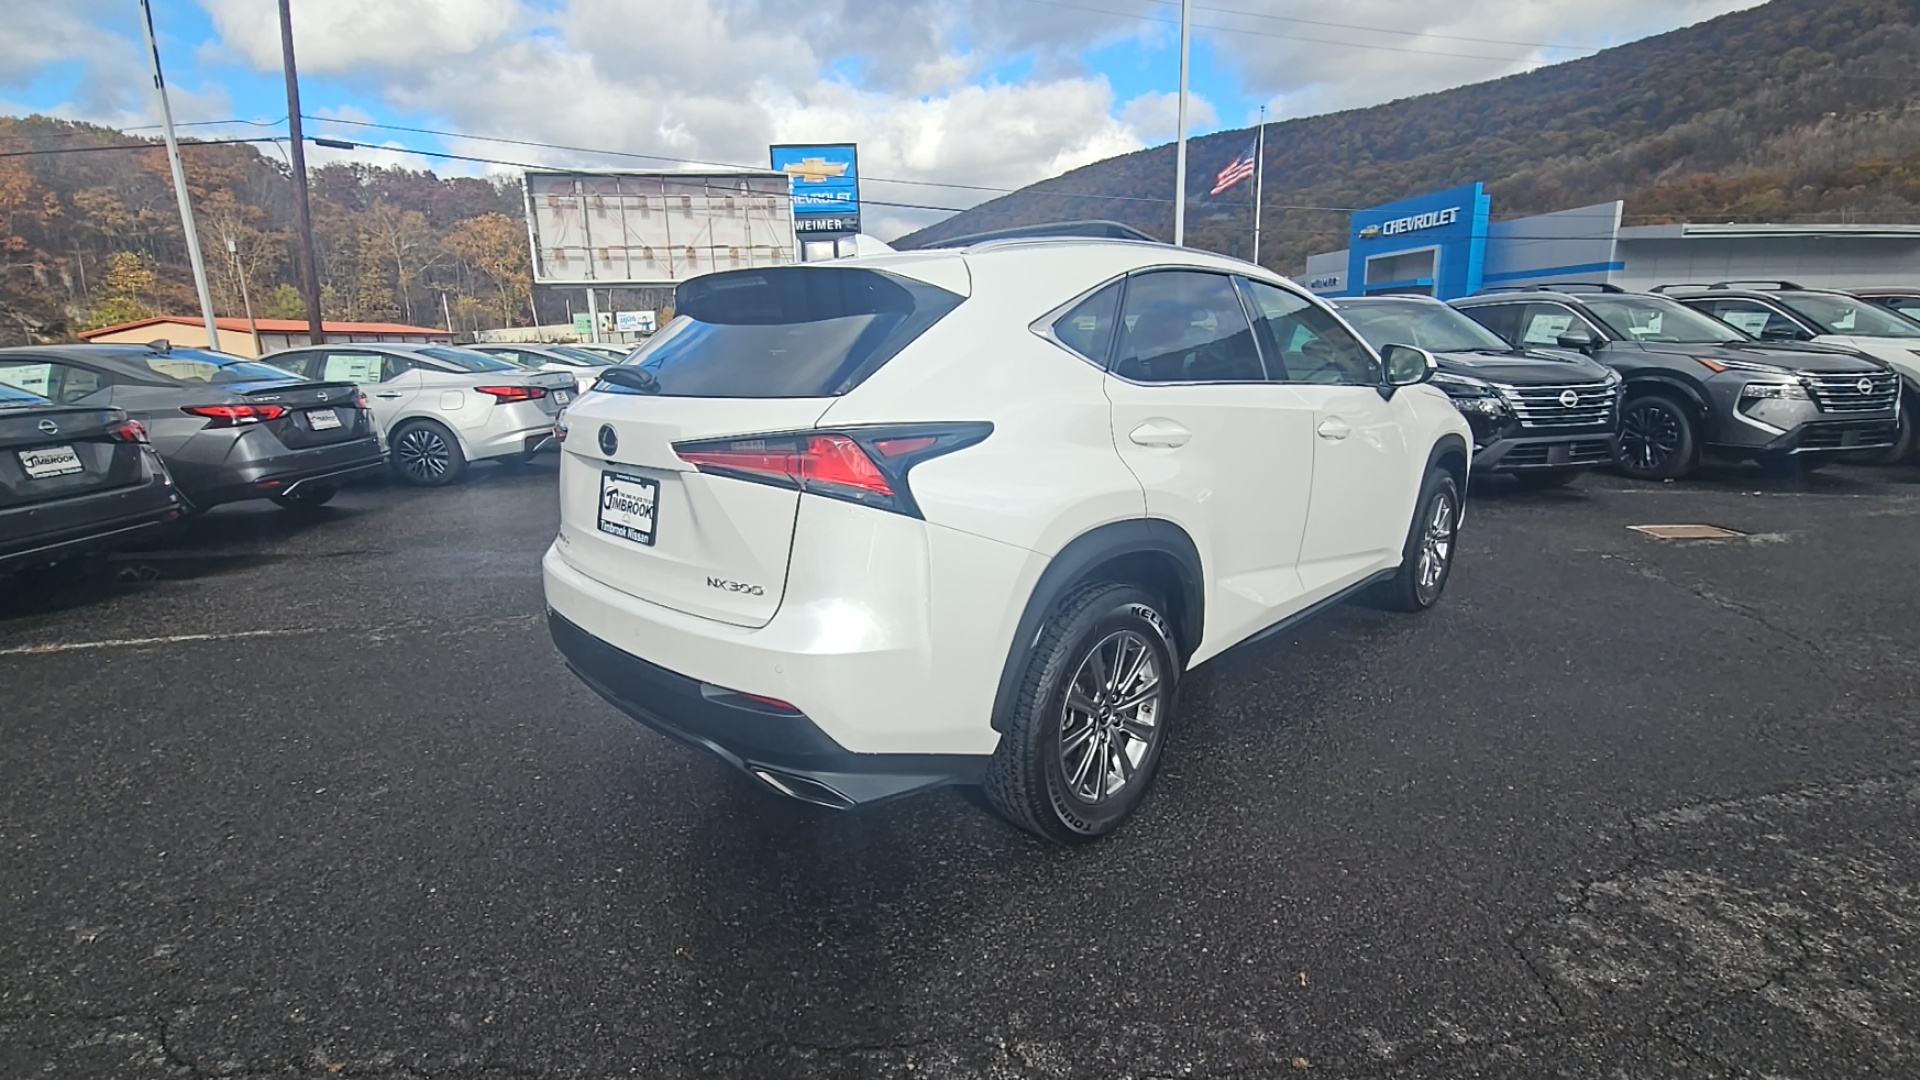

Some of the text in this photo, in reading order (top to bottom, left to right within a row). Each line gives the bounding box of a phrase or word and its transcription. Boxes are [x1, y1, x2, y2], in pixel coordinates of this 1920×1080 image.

[796, 219, 842, 231] WEIMER
[1383, 207, 1461, 235] CHEVROLET
[604, 487, 654, 519] TIMBROOK
[601, 520, 650, 543] Timbrook Nissan
[1130, 606, 1171, 640] KELLY
